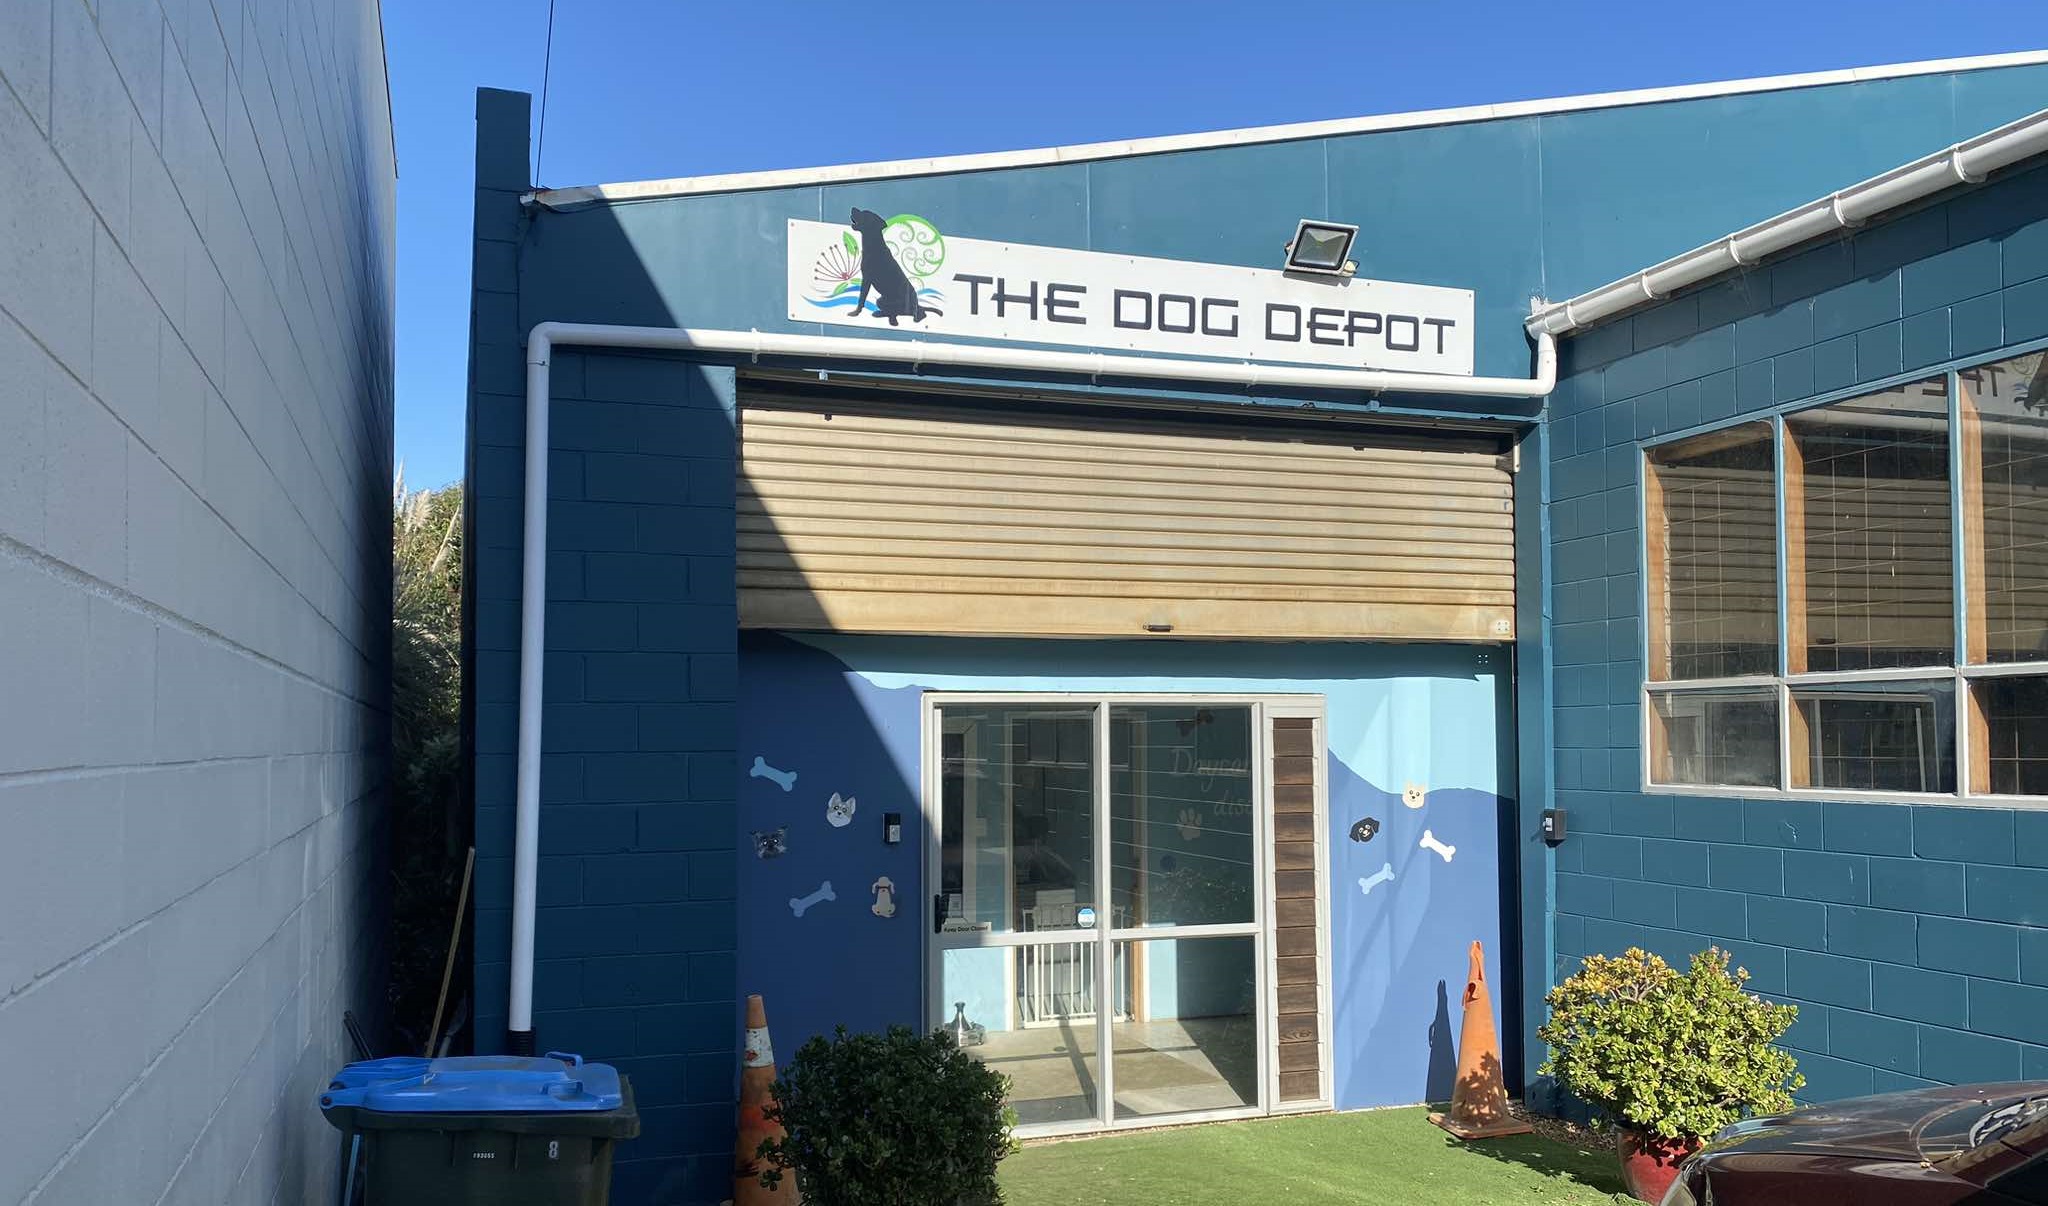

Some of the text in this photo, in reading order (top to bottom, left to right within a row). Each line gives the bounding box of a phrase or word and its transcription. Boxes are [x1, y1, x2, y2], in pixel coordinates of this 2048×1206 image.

[952, 273, 1456, 355] THE DOG DEPOT
[548, 1140, 558, 1159] 8
